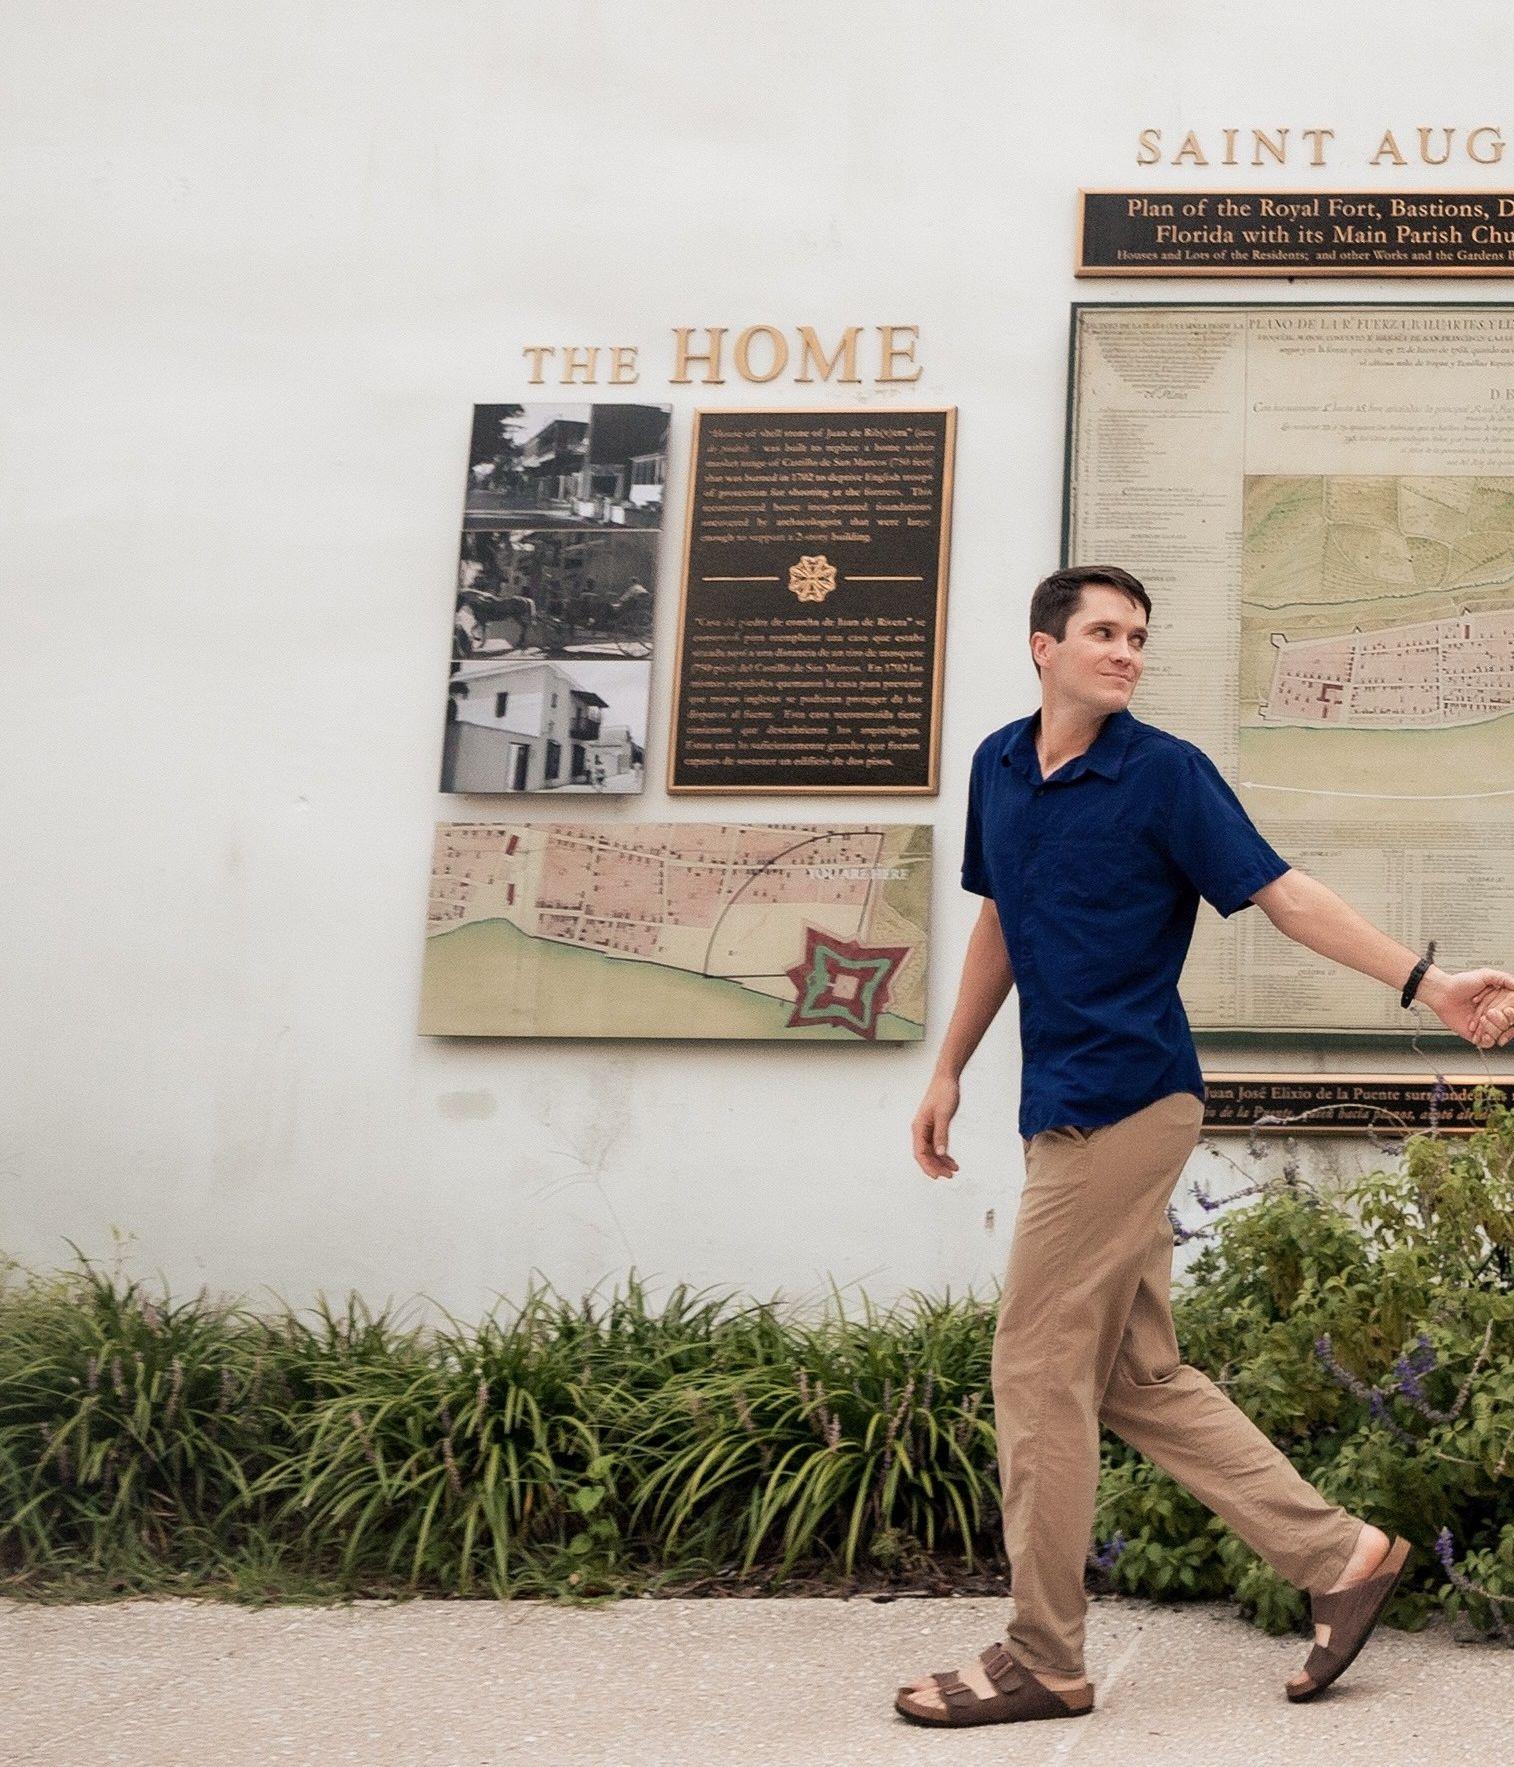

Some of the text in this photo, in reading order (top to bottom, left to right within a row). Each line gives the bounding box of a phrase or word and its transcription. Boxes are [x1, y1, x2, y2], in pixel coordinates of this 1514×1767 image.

[1135, 127, 1334, 167] SAINT
[1126, 198, 1174, 217] Plan
[1181, 197, 1208, 216] of
[1216, 198, 1251, 217] the
[1259, 197, 1319, 222] Royal
[1328, 198, 1382, 220] Fort,
[1390, 198, 1490, 220] Bastions,
[1155, 224, 1234, 243] Florida
[1241, 224, 1290, 243] with
[1297, 224, 1324, 243] its
[1332, 224, 1387, 244] Main
[1396, 224, 1462, 244] Parish
[1116, 249, 1159, 260] Houses
[1160, 248, 1182, 260] and
[1184, 249, 1210, 260] Lots
[1212, 249, 1227, 260] of
[1230, 249, 1249, 260] the
[1251, 249, 1309, 261] Residents;
[1315, 249, 1336, 260] and
[1338, 249, 1371, 260] other
[1372, 249, 1409, 260] Works
[1411, 249, 1432, 260] and
[1435, 249, 1454, 260] the
[1456, 249, 1504, 260] Gardens
[523, 324, 924, 384] THE HOME
[1237, 1086, 1266, 1102] José
[1270, 1086, 1312, 1100] Elixio
[1315, 1086, 1333, 1100] de
[1336, 1086, 1349, 1100] la
[1353, 1087, 1401, 1101] Puente
